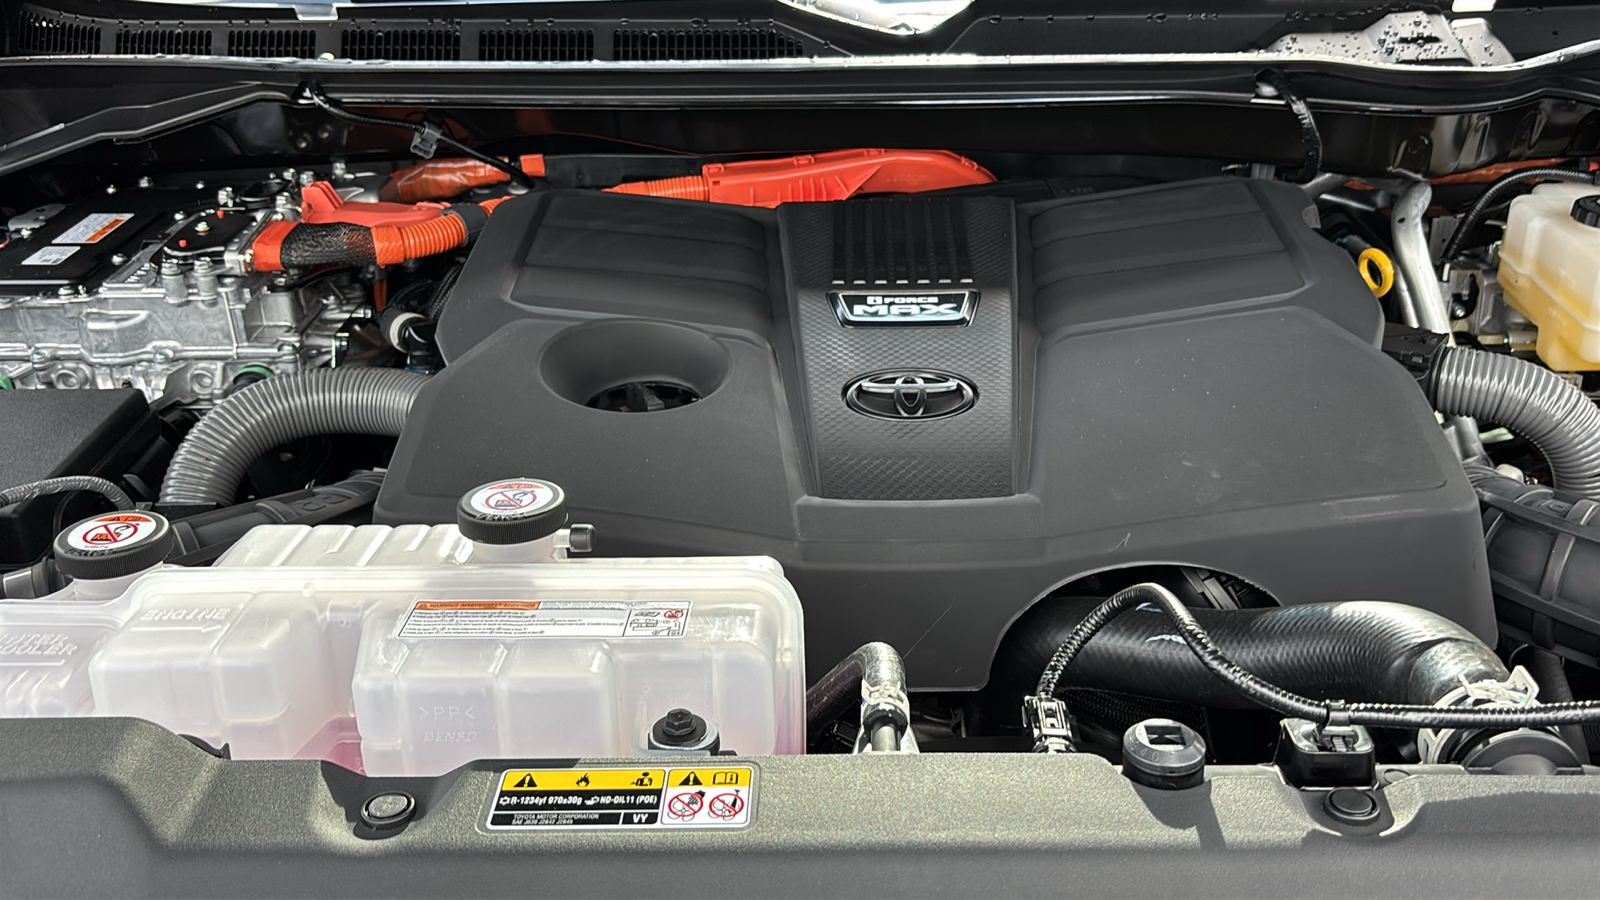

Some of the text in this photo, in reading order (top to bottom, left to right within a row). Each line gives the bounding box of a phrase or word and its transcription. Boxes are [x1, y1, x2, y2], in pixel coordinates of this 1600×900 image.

[853, 303, 958, 315] MAX
[140, 608, 231, 621] ENGINE
[0, 643, 78, 655] OOLER
[423, 731, 477, 742] DENSO
[510, 796, 547, 805] R-1234yf
[600, 795, 635, 804] ND-OIL11
[636, 795, 657, 804] (POE)
[633, 814, 648, 823] VY
